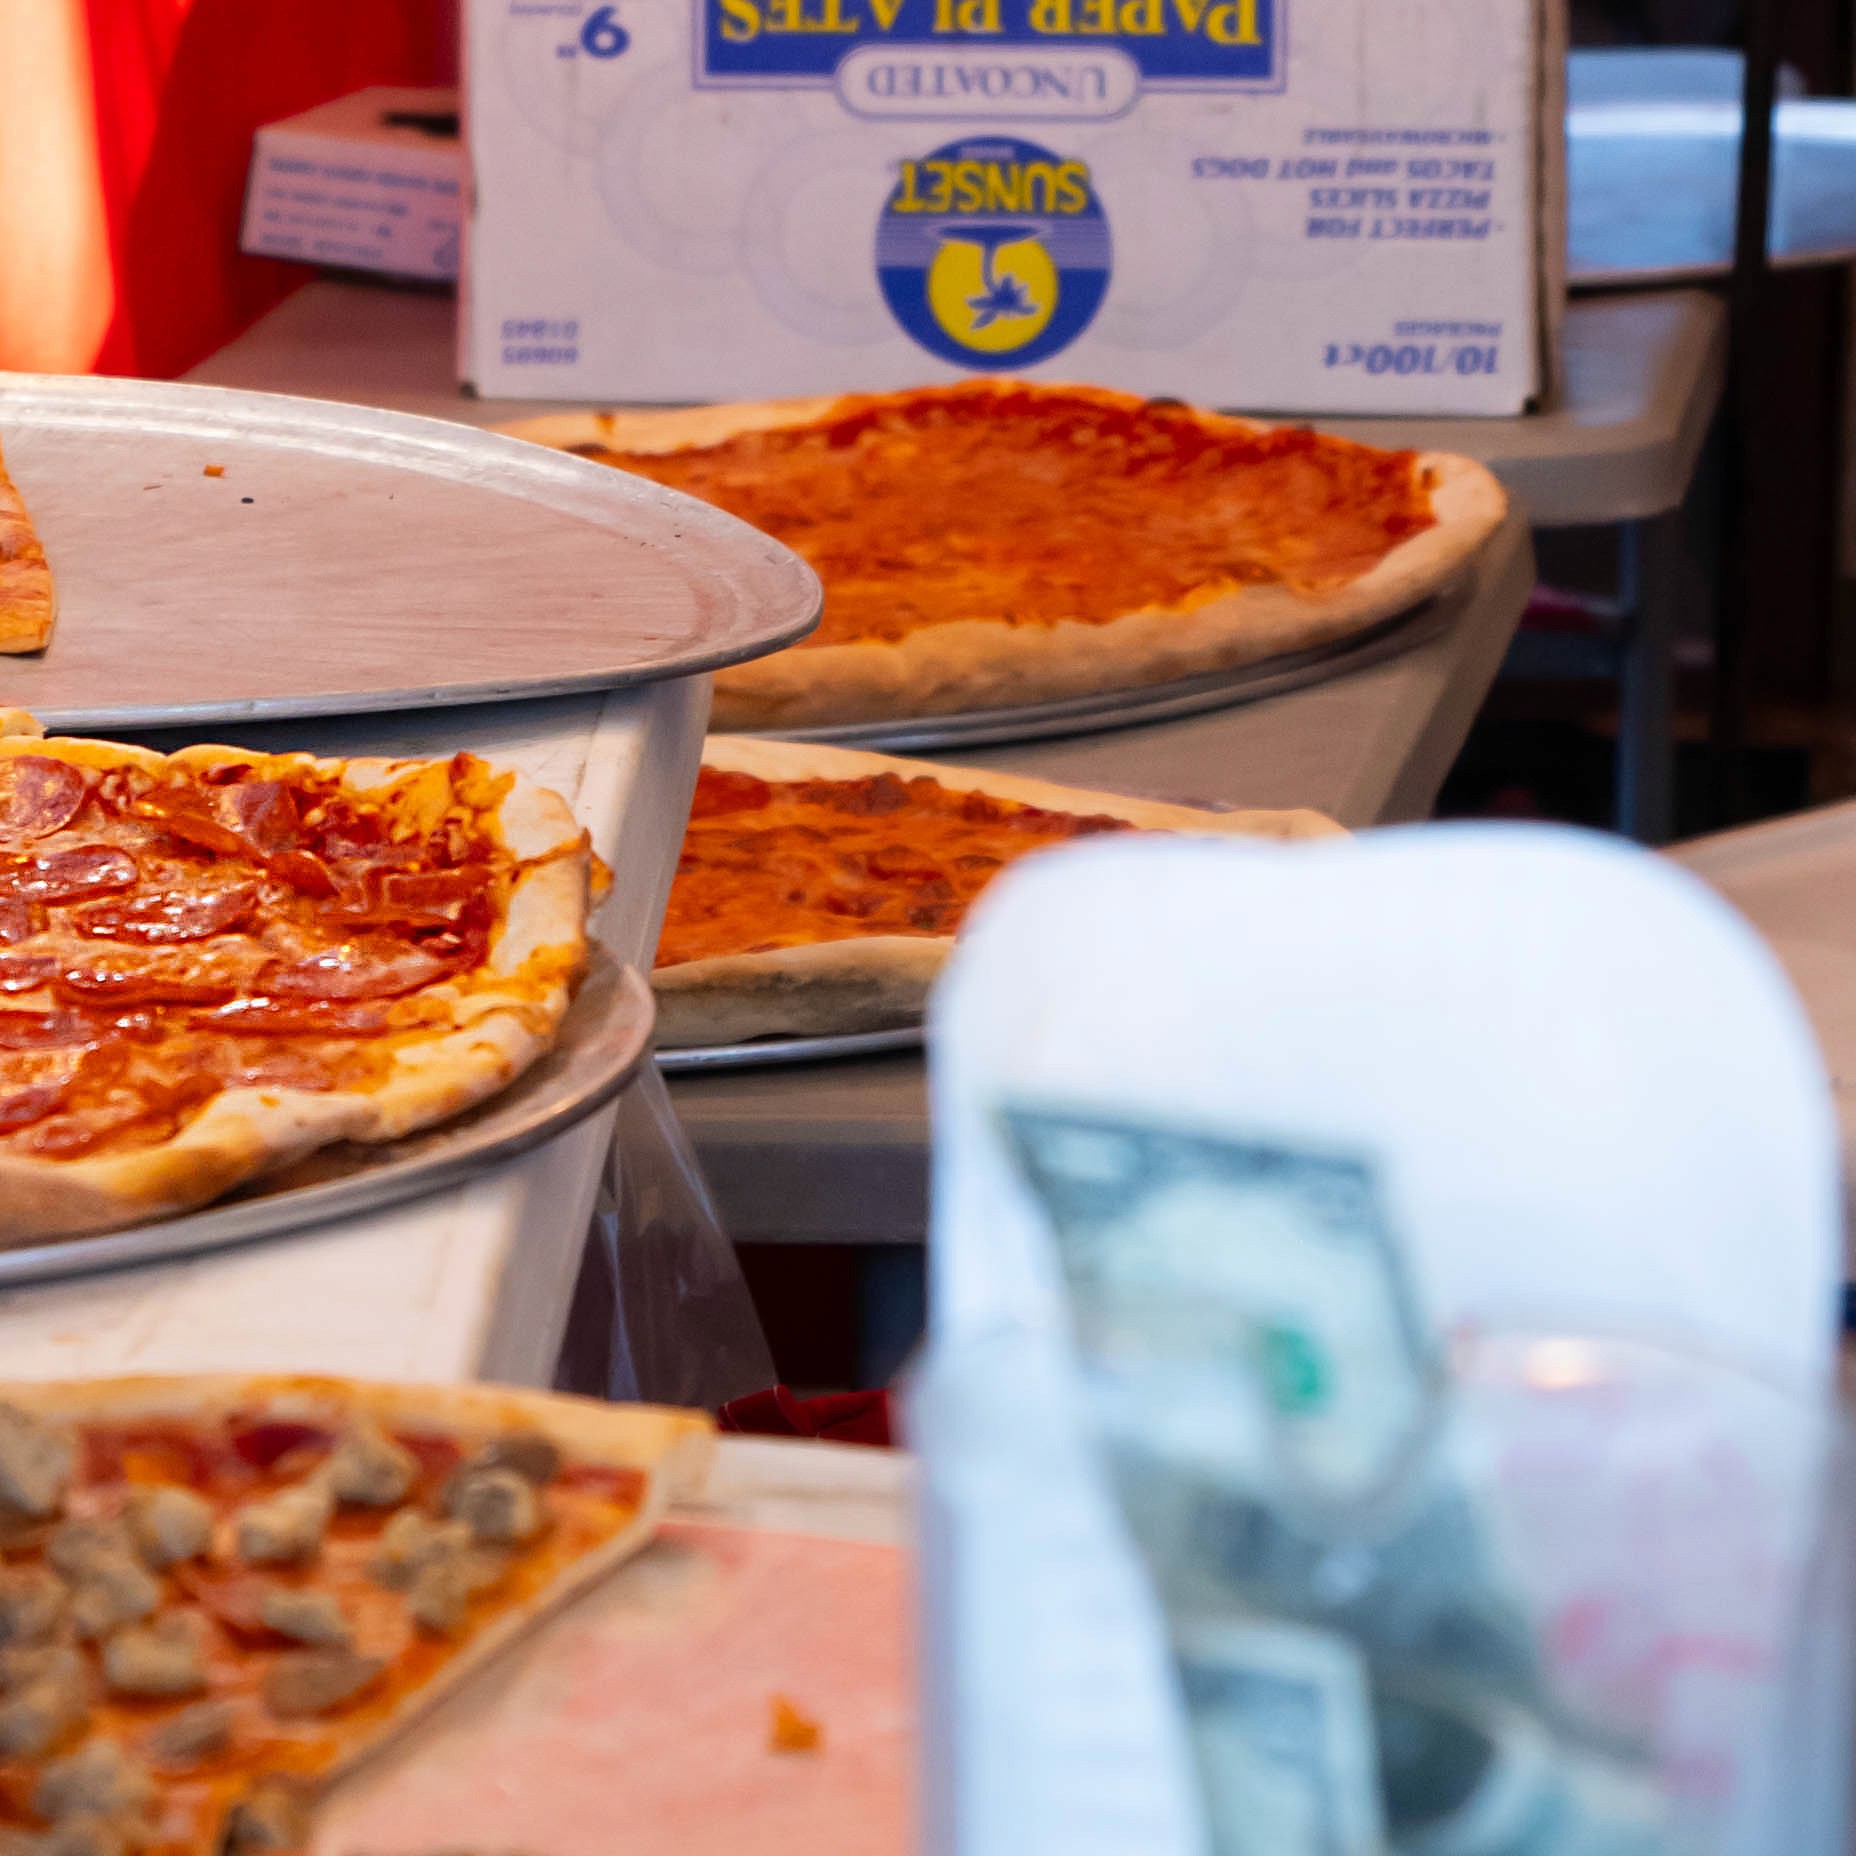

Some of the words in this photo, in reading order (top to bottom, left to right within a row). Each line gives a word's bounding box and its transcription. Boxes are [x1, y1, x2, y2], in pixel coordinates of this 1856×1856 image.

[867, 63, 1107, 101] UNCOATED
[1190, 156, 1270, 180] DOGS
[1277, 157, 1338, 180] HOT
[1406, 157, 1495, 180] TACOS
[891, 158, 1089, 215] SUNSET
[1308, 186, 1399, 210] SLICES
[1407, 187, 1492, 211] PIZZA
[1305, 216, 1362, 239] FOR
[1369, 216, 1492, 240] PERFECT
